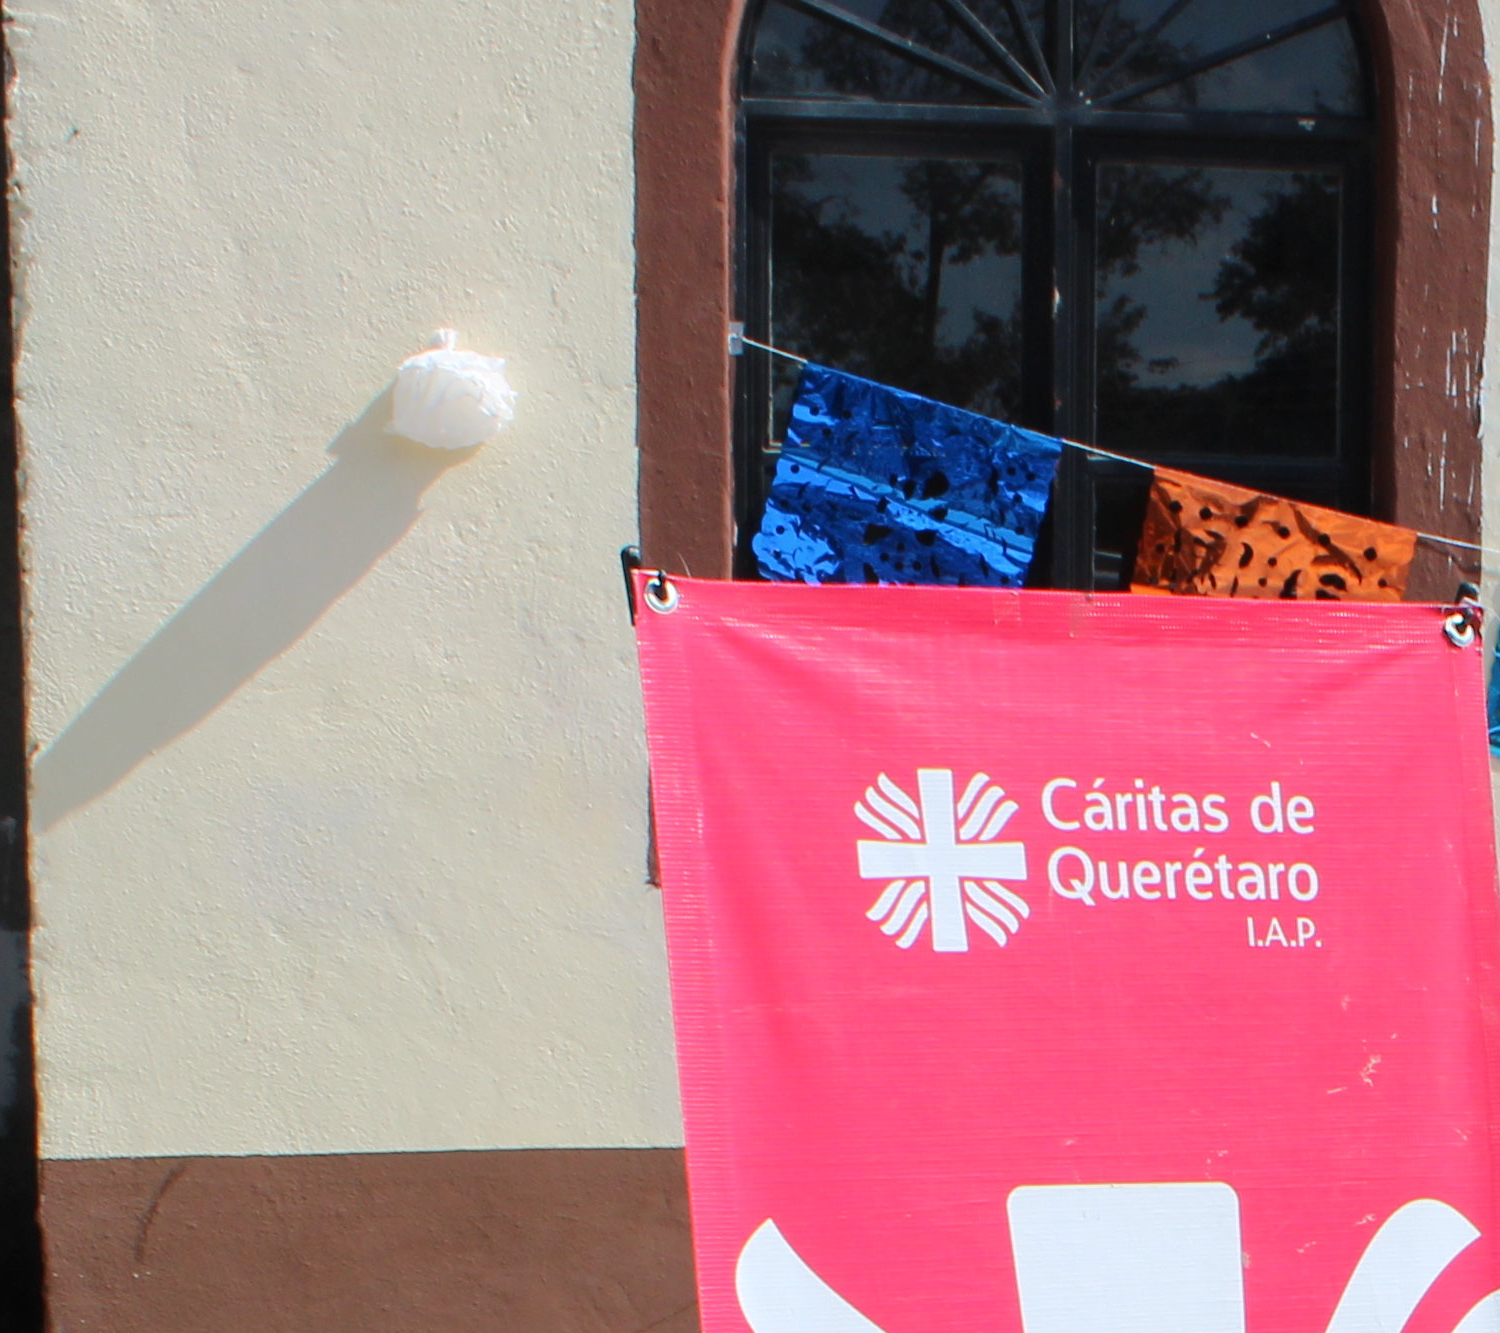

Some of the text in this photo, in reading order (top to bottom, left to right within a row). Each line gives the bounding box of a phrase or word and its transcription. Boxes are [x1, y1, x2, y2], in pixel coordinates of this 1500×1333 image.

[1040, 776, 1316, 834] Cáritas de
[1047, 846, 1320, 907] Querétaro
[1246, 916, 1323, 949] I.A.P.
